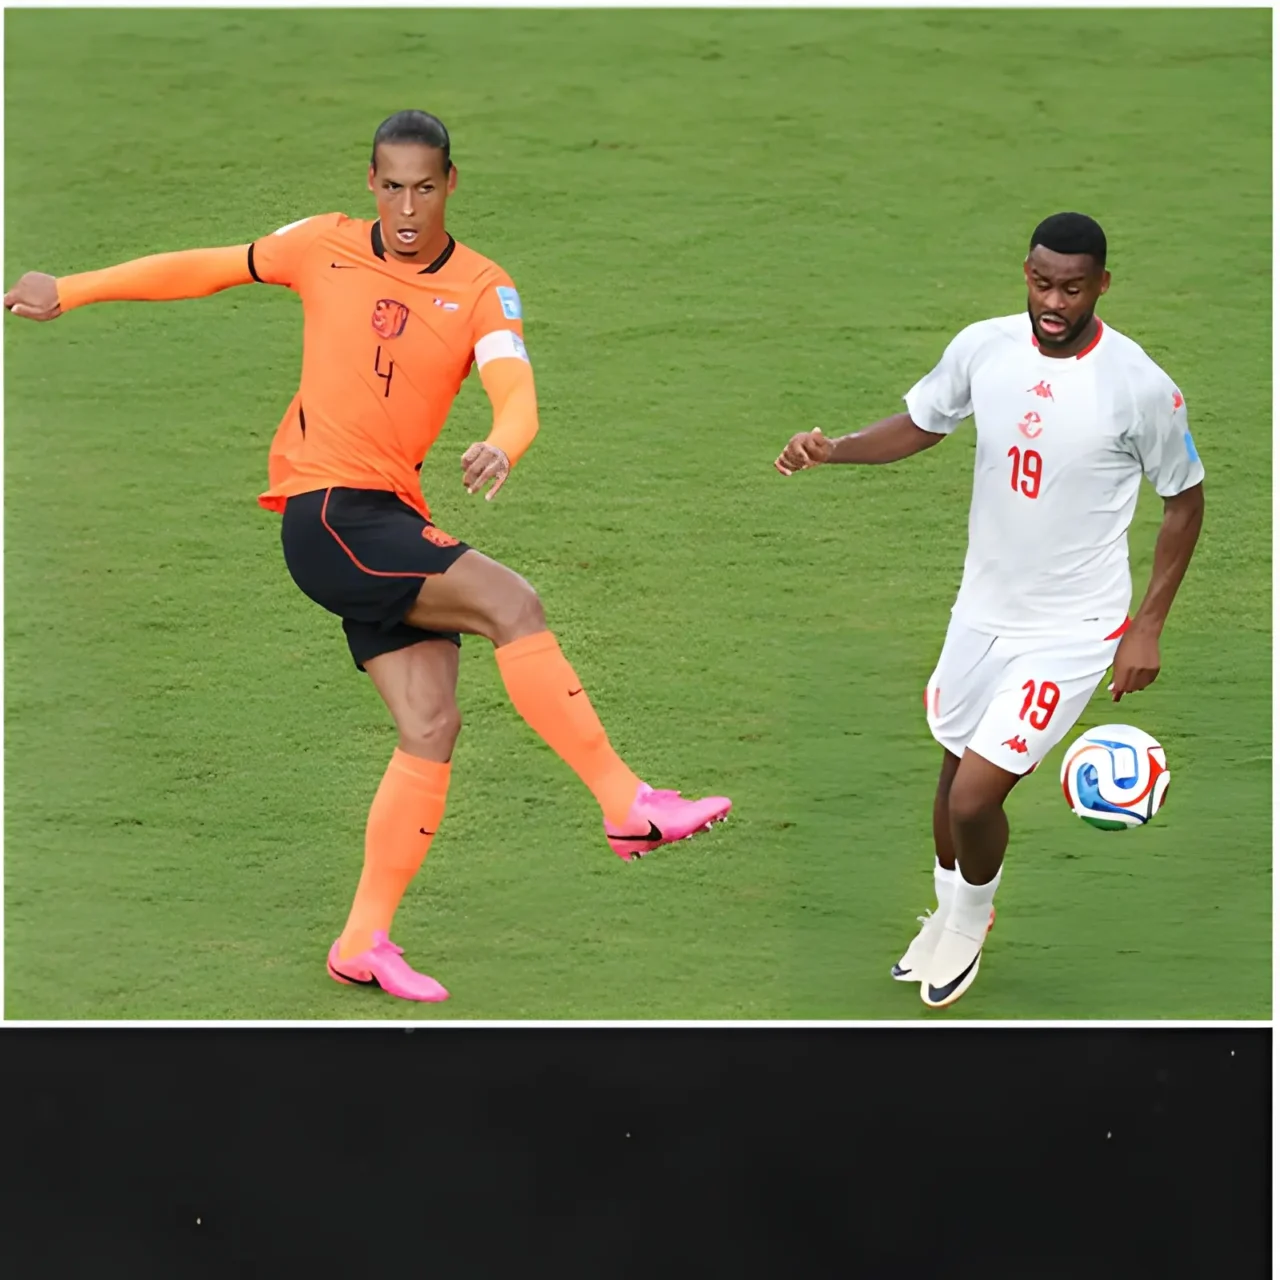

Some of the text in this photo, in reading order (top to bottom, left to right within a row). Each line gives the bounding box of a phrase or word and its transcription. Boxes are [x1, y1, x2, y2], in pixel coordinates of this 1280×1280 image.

[374, 345, 394, 397] 4
[1007, 445, 1043, 499] 19
[1018, 678, 1061, 732] 19
